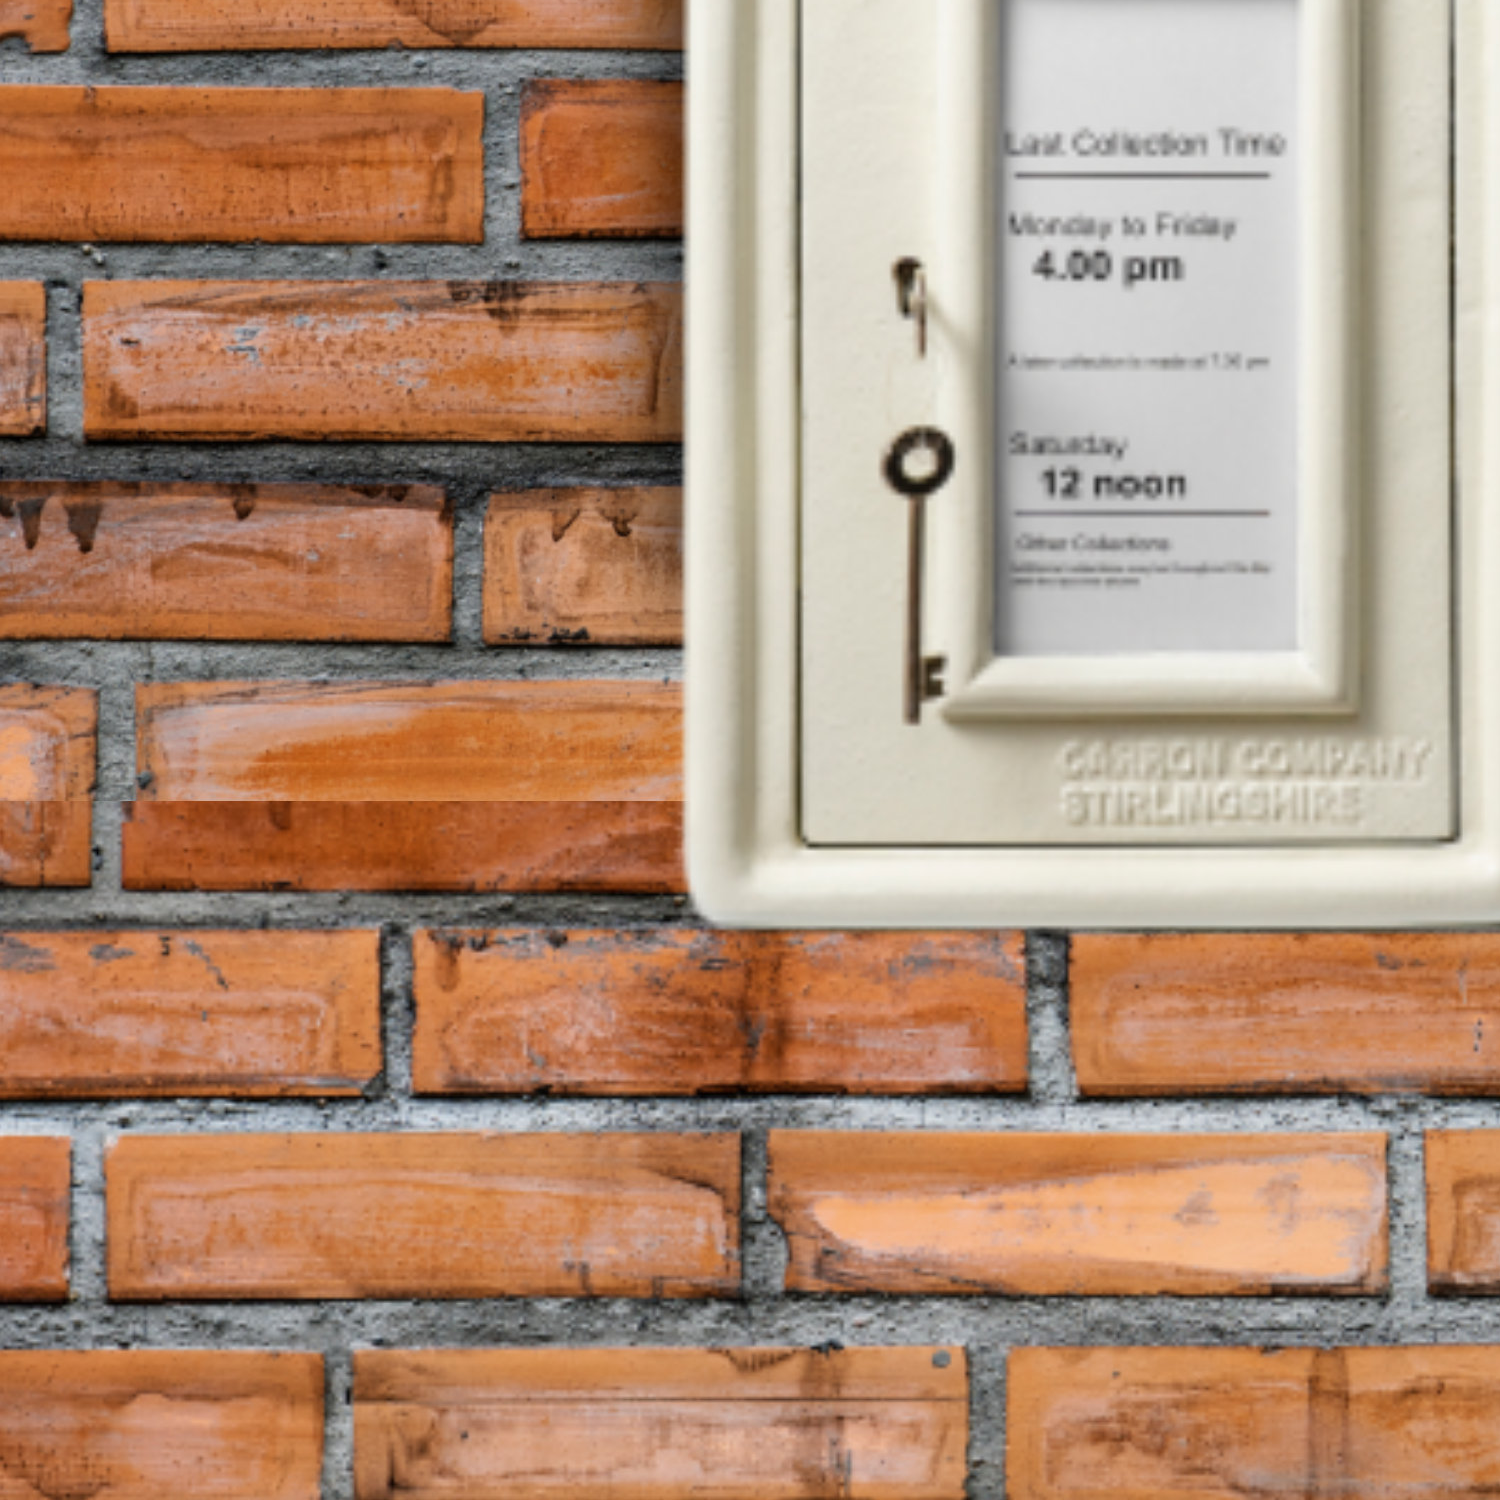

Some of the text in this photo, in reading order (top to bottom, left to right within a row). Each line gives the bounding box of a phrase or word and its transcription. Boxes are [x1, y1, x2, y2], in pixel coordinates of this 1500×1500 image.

[1003, 127, 1288, 157] Last Collection Time
[1008, 211, 1238, 241] Monday to Friday
[1032, 250, 1186, 290] 4.00 pm
[1008, 431, 1128, 461] Saturday
[1041, 466, 1188, 499] 12 noon
[1233, 736, 1433, 780] COMPANY
